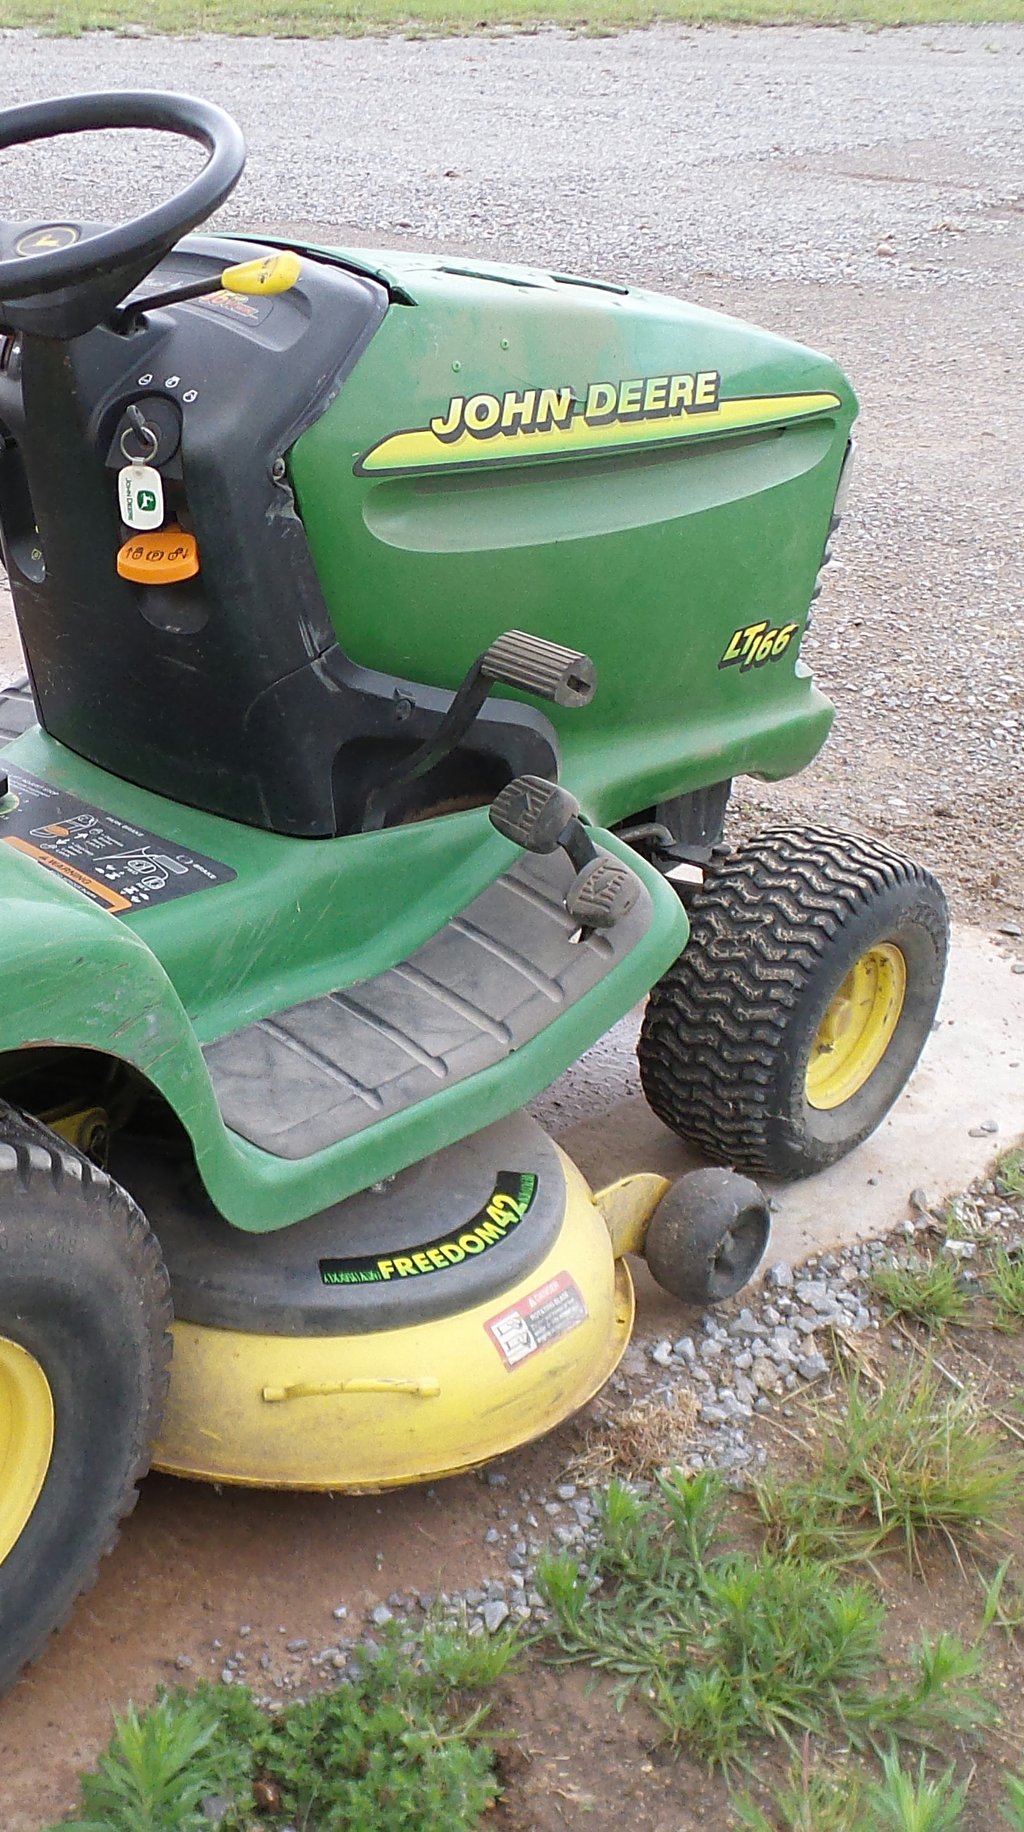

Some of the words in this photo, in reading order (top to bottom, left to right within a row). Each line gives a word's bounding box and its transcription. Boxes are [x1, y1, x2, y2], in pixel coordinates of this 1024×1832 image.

[431, 386, 575, 443] JOHN
[583, 370, 721, 426] DEERE
[719, 620, 798, 672] LT166
[48, 858, 93, 885] WARNING
[192, 863, 217, 880] BRAKE
